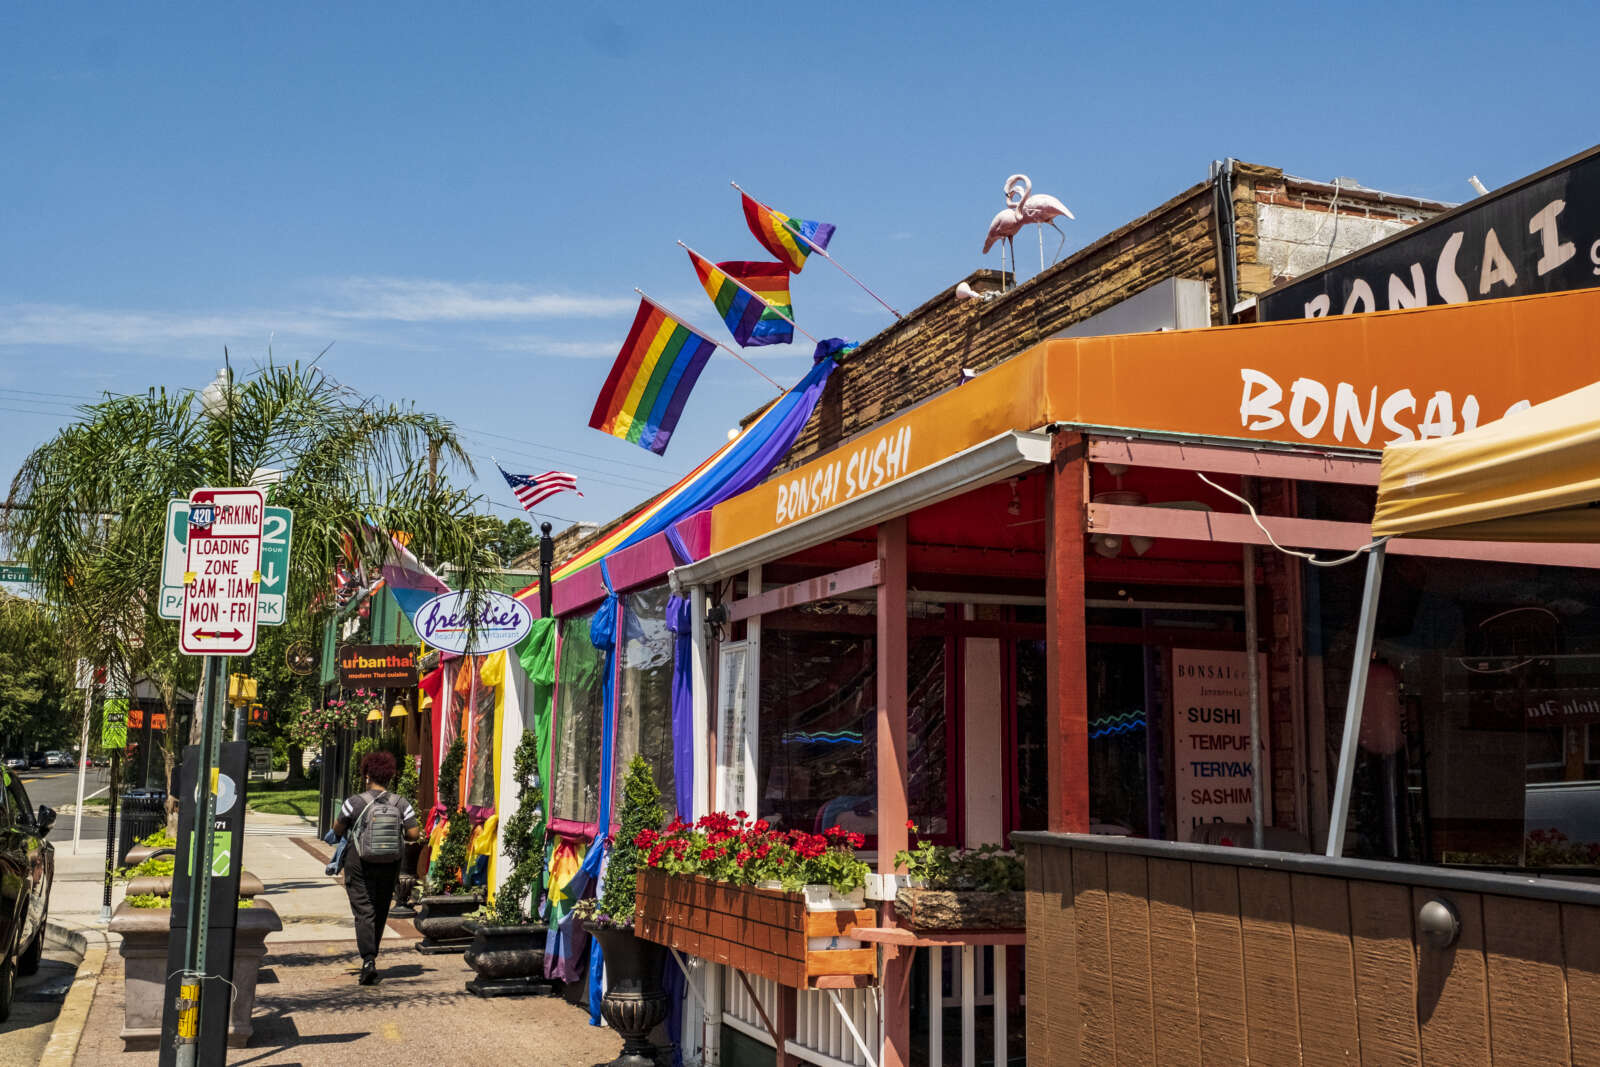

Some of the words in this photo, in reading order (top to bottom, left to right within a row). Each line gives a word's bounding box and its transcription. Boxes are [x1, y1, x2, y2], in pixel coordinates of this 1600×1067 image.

[1240, 369, 1479, 446] BONSAI
[776, 461, 841, 524] BONSAI
[846, 425, 911, 498] SUSHI
[193, 509, 210, 523] 420
[214, 505, 258, 525] PARKING
[263, 516, 287, 544] 2
[197, 540, 249, 555] LOADING
[204, 560, 239, 575] ZONE
[190, 578, 216, 598] 8AM
[228, 579, 254, 598] 11AM
[190, 603, 219, 622] MON
[230, 603, 251, 622] FRI
[342, 651, 413, 669] urbanthai
[1178, 664, 1231, 679] BONSAI
[1188, 707, 1240, 724] SUSHI
[1190, 762, 1252, 777] TERIYAK
[1191, 788, 1252, 804] SASHIM
